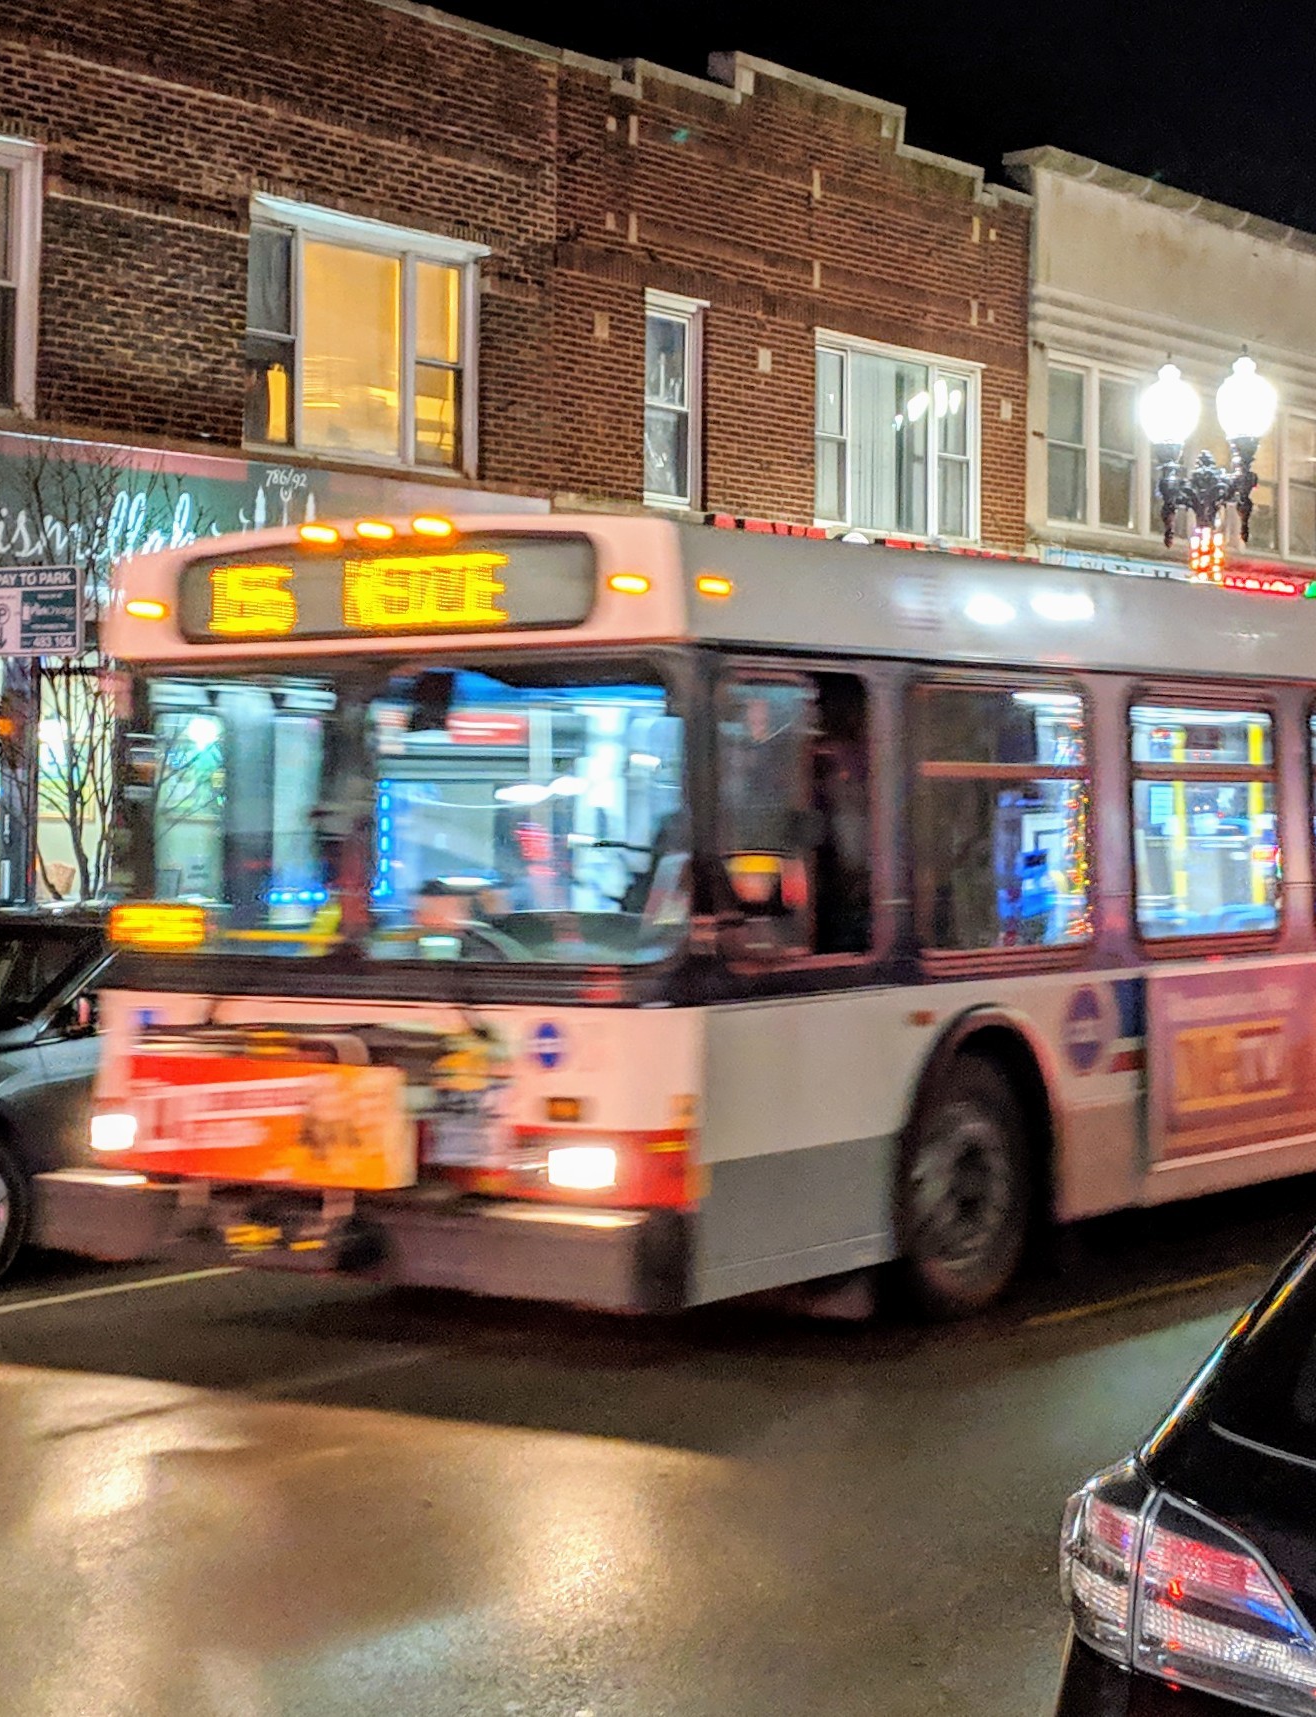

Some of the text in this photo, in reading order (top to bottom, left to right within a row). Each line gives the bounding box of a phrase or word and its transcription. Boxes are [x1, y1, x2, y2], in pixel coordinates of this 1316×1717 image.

[266, 469, 308, 489] 786/92
[20, 572, 37, 585] TO
[38, 571, 72, 585] PARK
